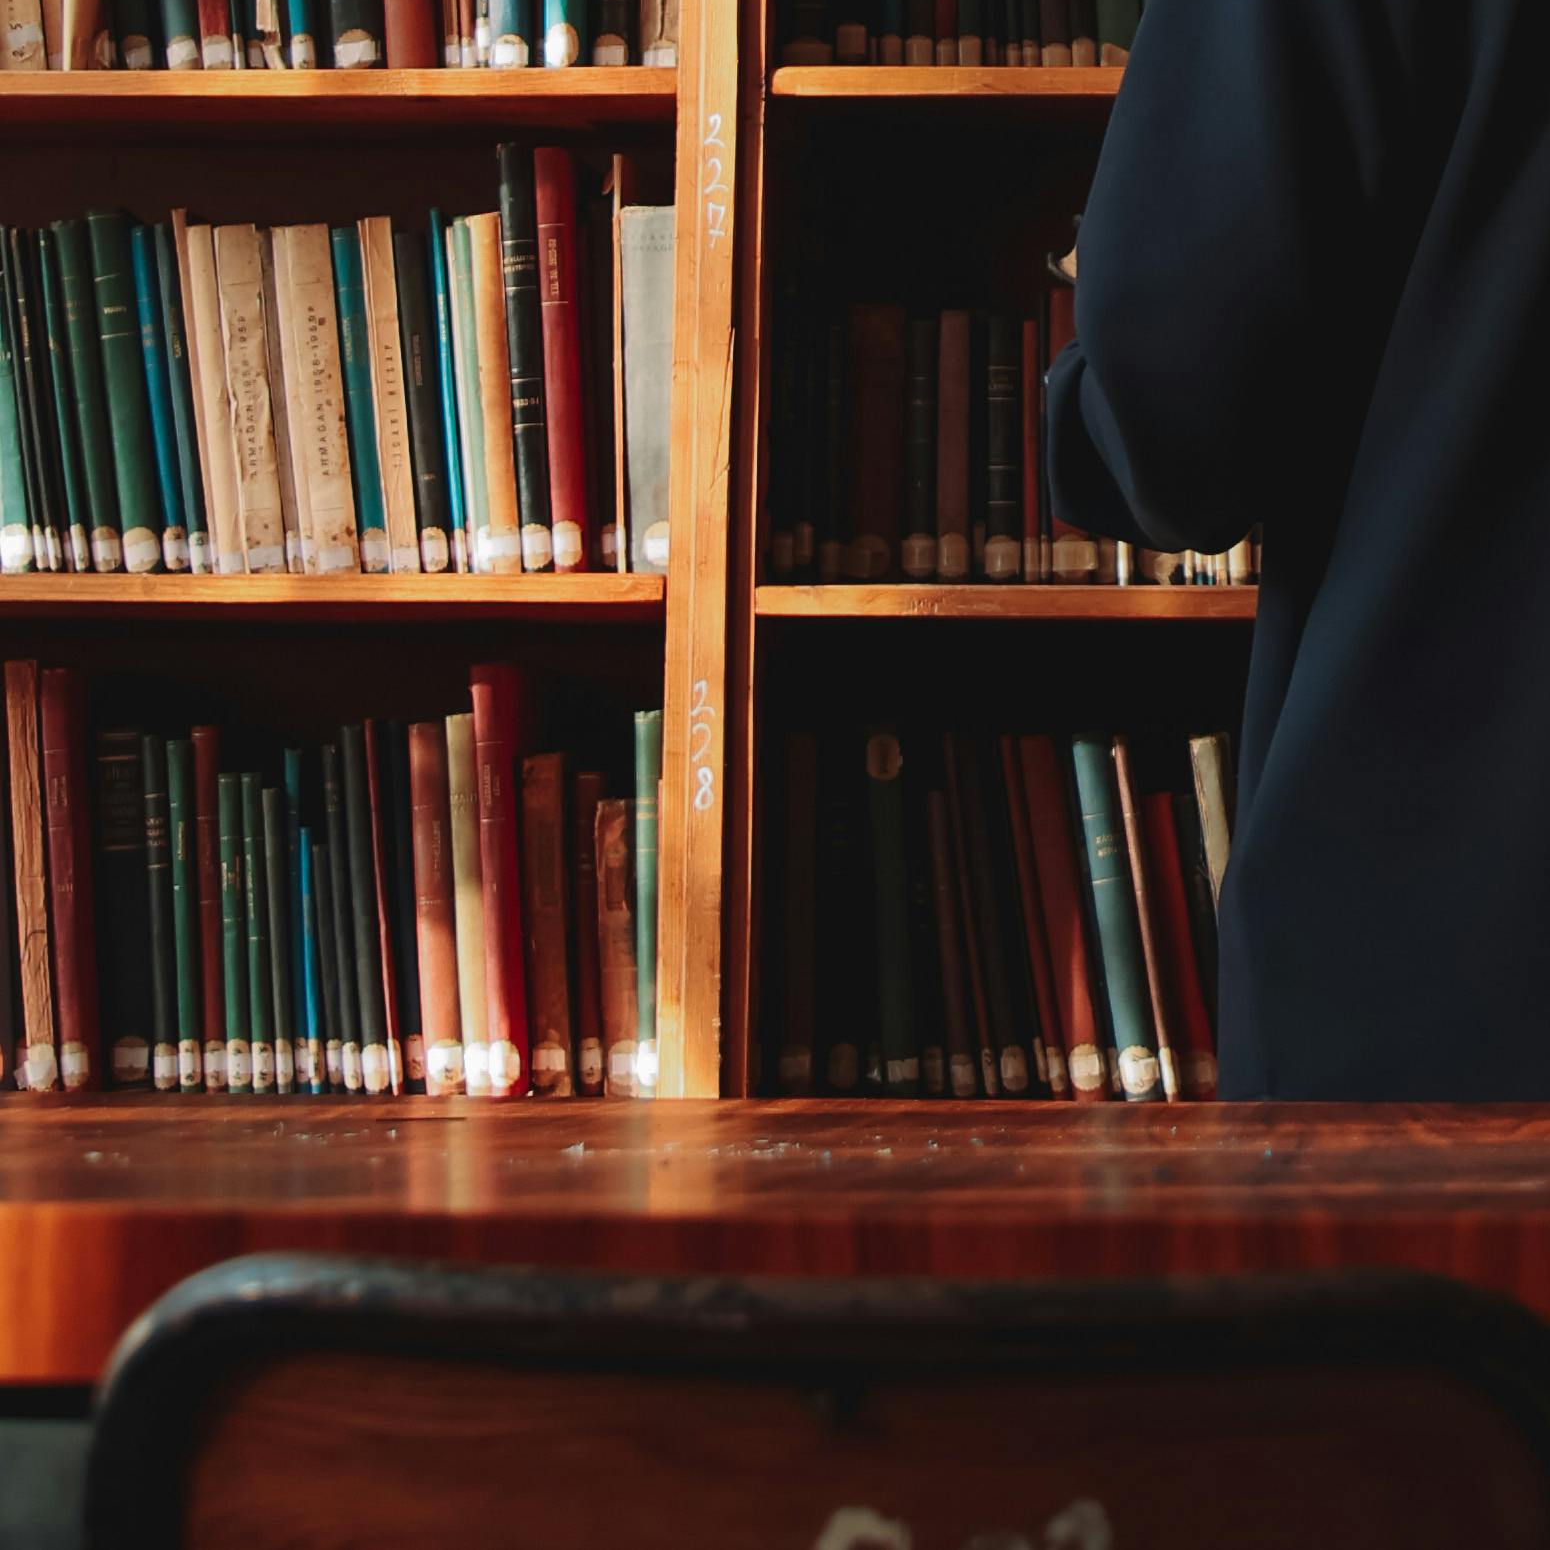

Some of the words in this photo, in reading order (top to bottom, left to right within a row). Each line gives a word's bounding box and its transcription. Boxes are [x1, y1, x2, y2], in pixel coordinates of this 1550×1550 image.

[704, 113, 728, 249] 227
[244, 404, 258, 480] ARMAĞAN
[315, 403, 331, 476] ARMAĞAN
[690, 680, 715, 810] 228
